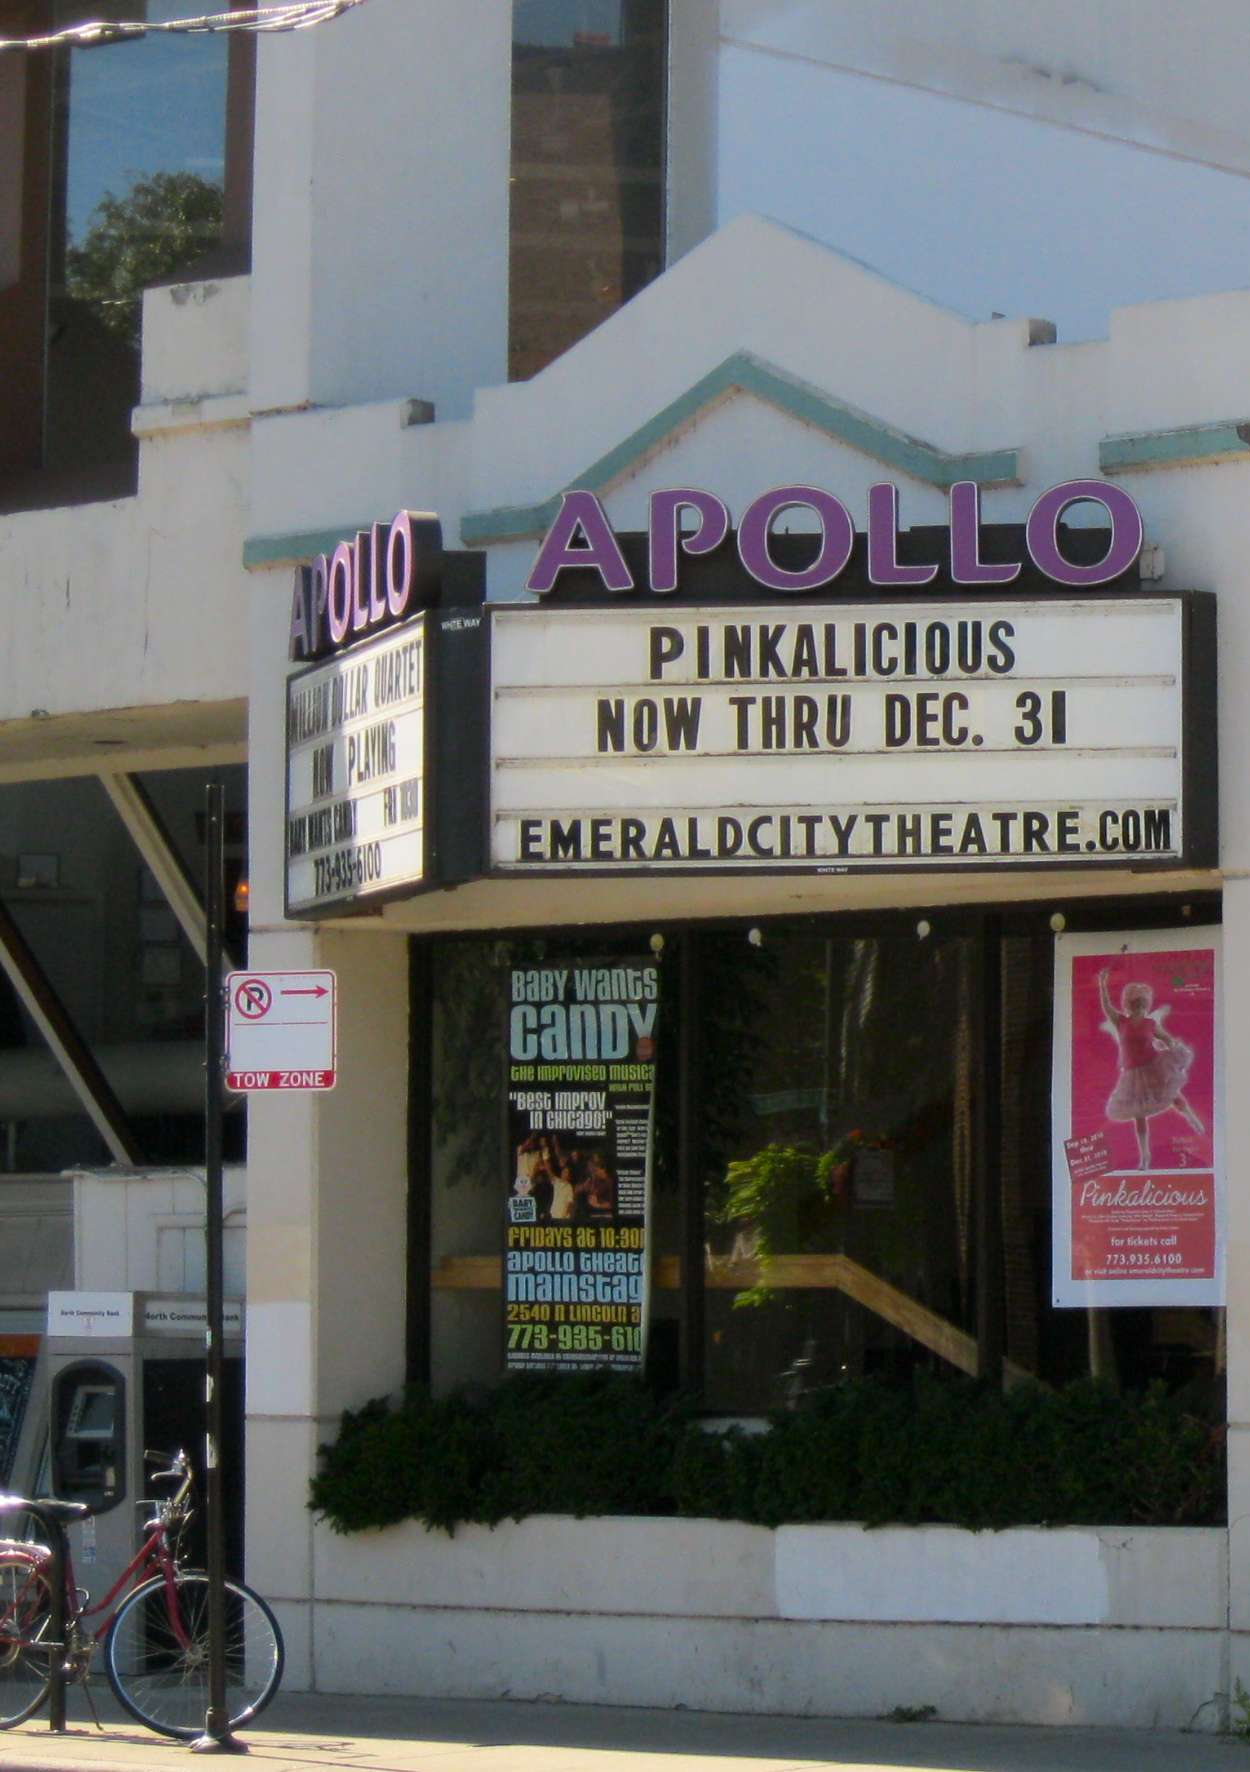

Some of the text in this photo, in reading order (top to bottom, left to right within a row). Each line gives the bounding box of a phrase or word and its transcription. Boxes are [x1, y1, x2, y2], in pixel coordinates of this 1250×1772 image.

[524, 479, 1144, 594] APOLLO
[289, 510, 413, 661] APOLLO
[464, 617, 481, 627] WAY
[374, 640, 421, 708] QUARTET
[650, 620, 1015, 680] PINKALICIOUS
[597, 690, 1067, 752] NOW THRU DEC. 31
[349, 721, 395, 786] PLAYING
[384, 784, 397, 827] FRI
[520, 808, 1171, 862] EMERALDCITYTHEATRE.COM
[314, 842, 381, 896] 773-935-6100
[233, 1072, 325, 1088] TOW ZONE
[1080, 1179, 1208, 1207] Pinkalicious
[1106, 1253, 1182, 1266] 773.935.6100
[1111, 1235, 1177, 1247] for tickets call
[170, 1311, 206, 1321] Commun
[223, 1313, 239, 1321] ank
[507, 1304, 549, 1321] 2540
